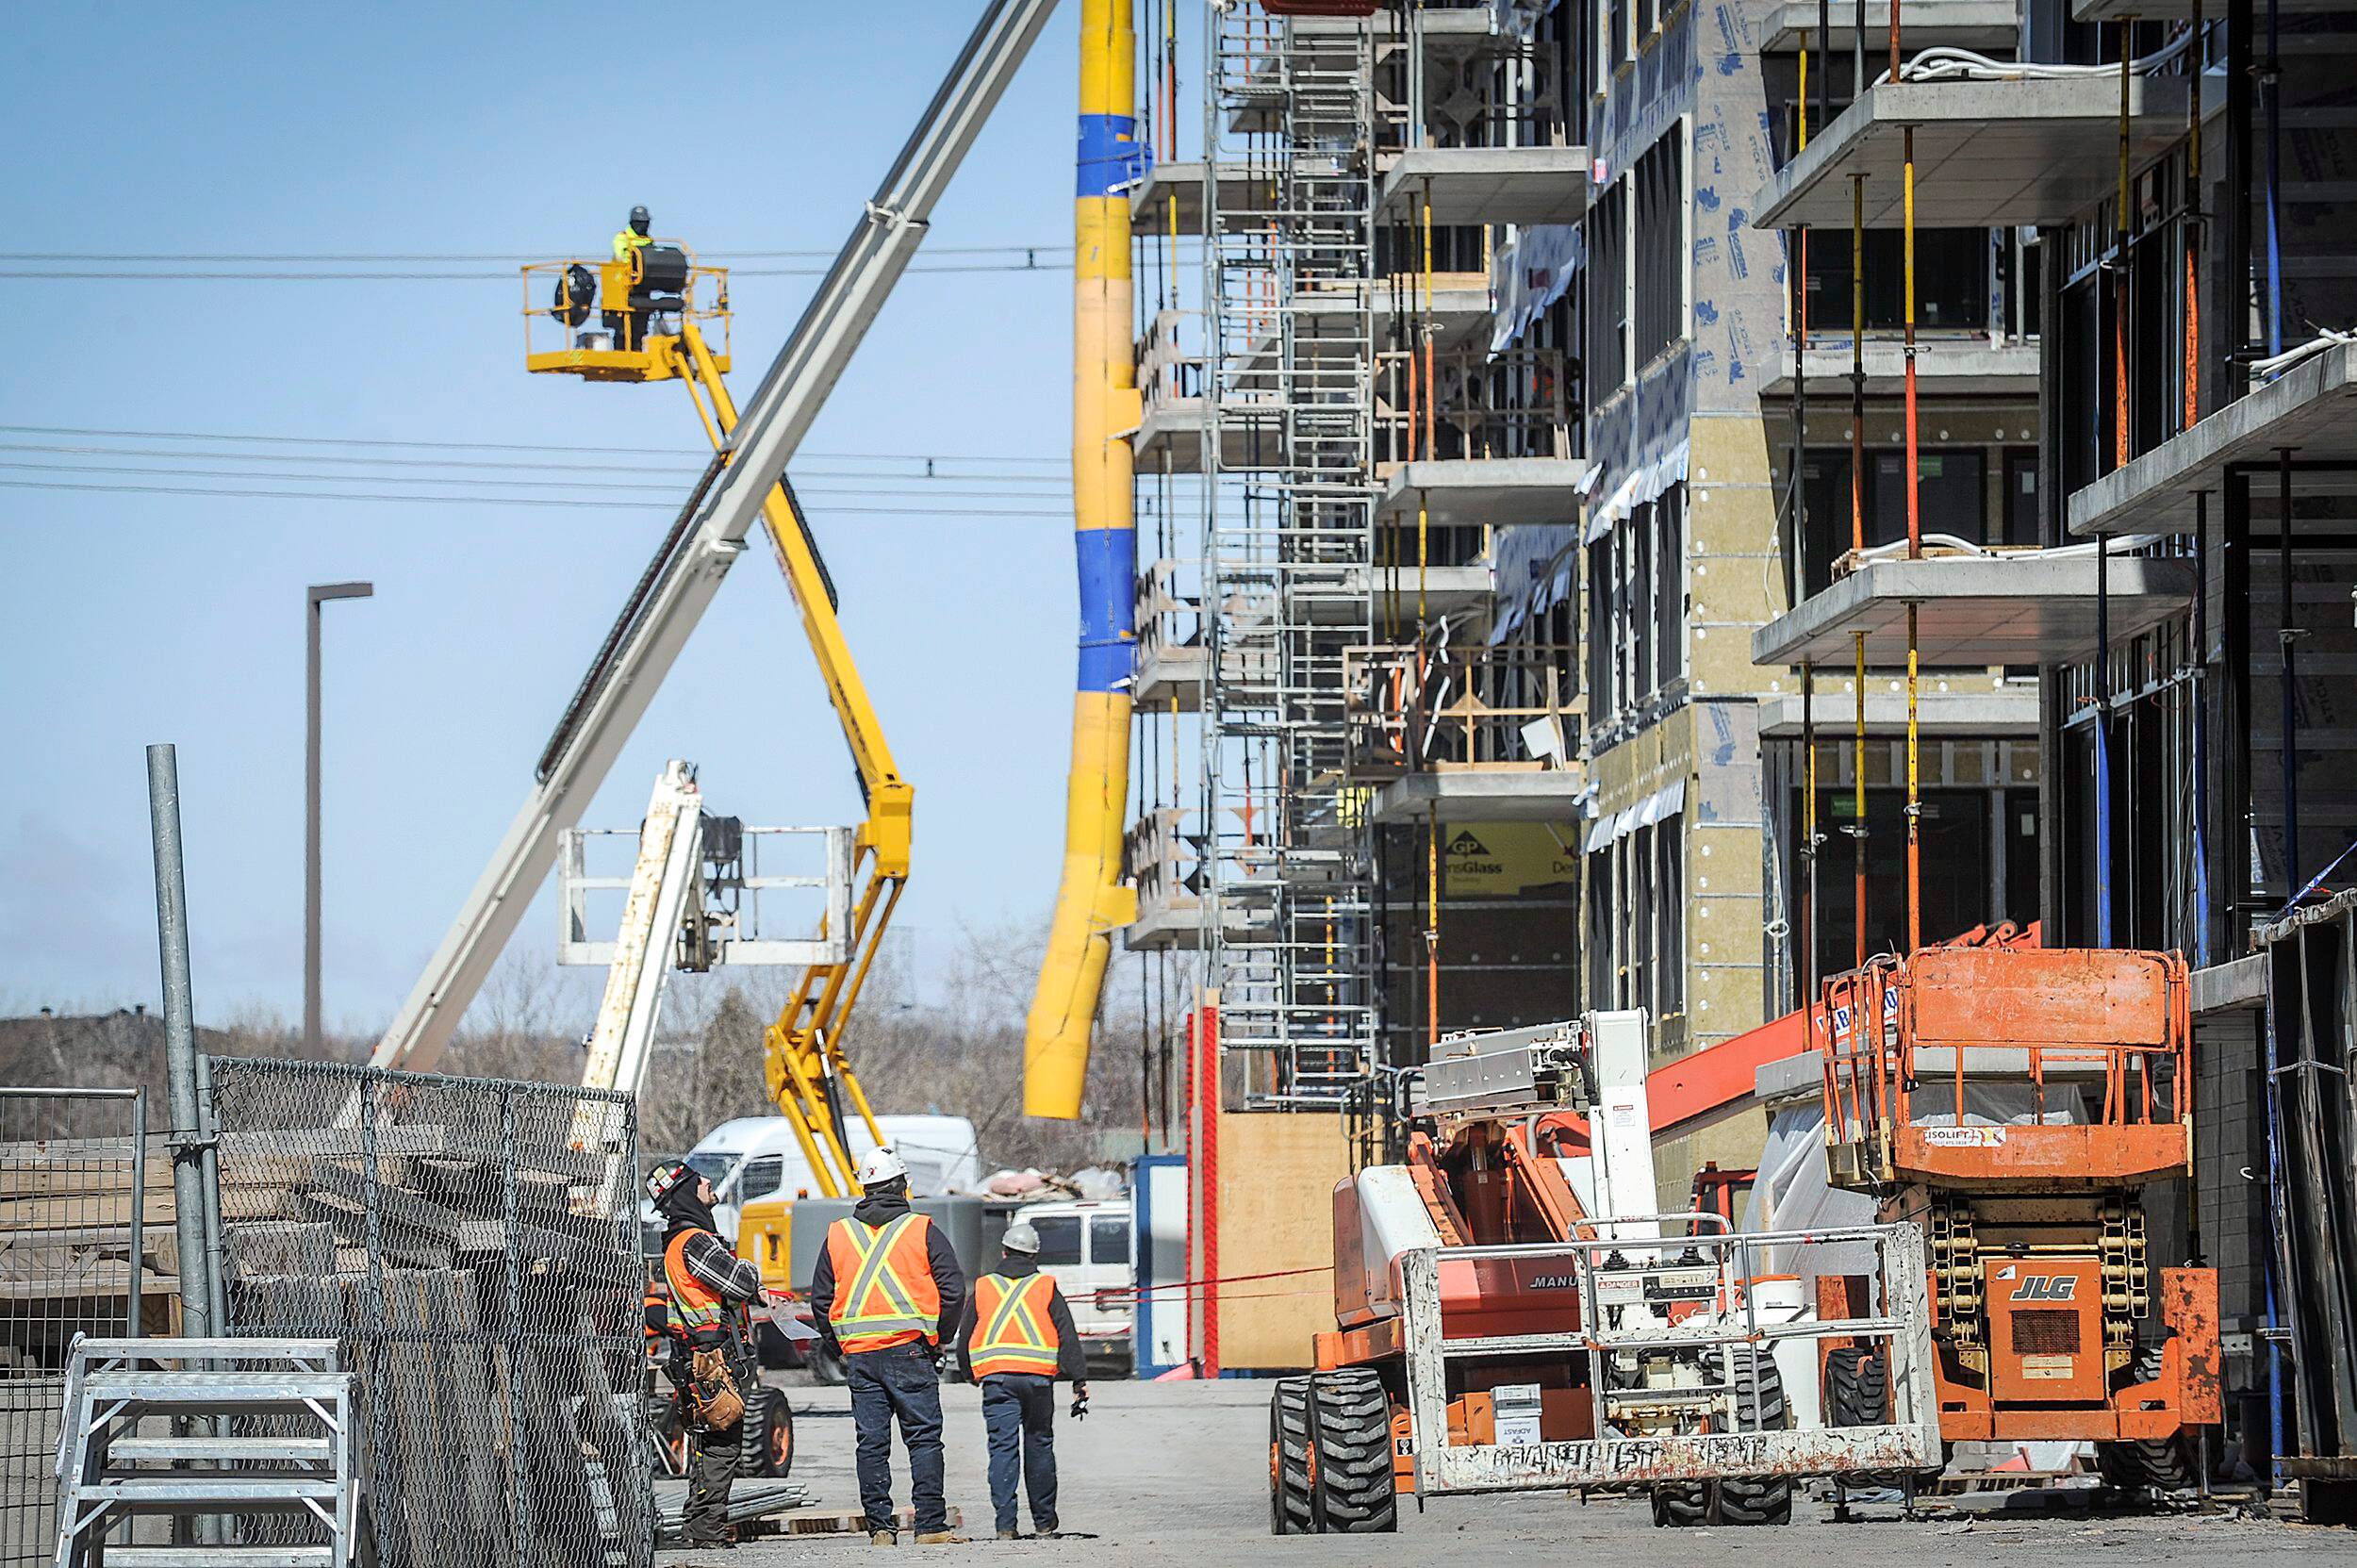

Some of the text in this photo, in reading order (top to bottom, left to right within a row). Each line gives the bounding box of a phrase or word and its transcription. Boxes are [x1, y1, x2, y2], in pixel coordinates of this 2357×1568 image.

[1730, 231, 1749, 278] SOPREMA
[1453, 841, 1478, 853] GP
[1447, 861, 1503, 874] nsGlass
[1530, 1276, 1579, 1288] MANU
[2009, 1276, 2078, 1301] JLG
